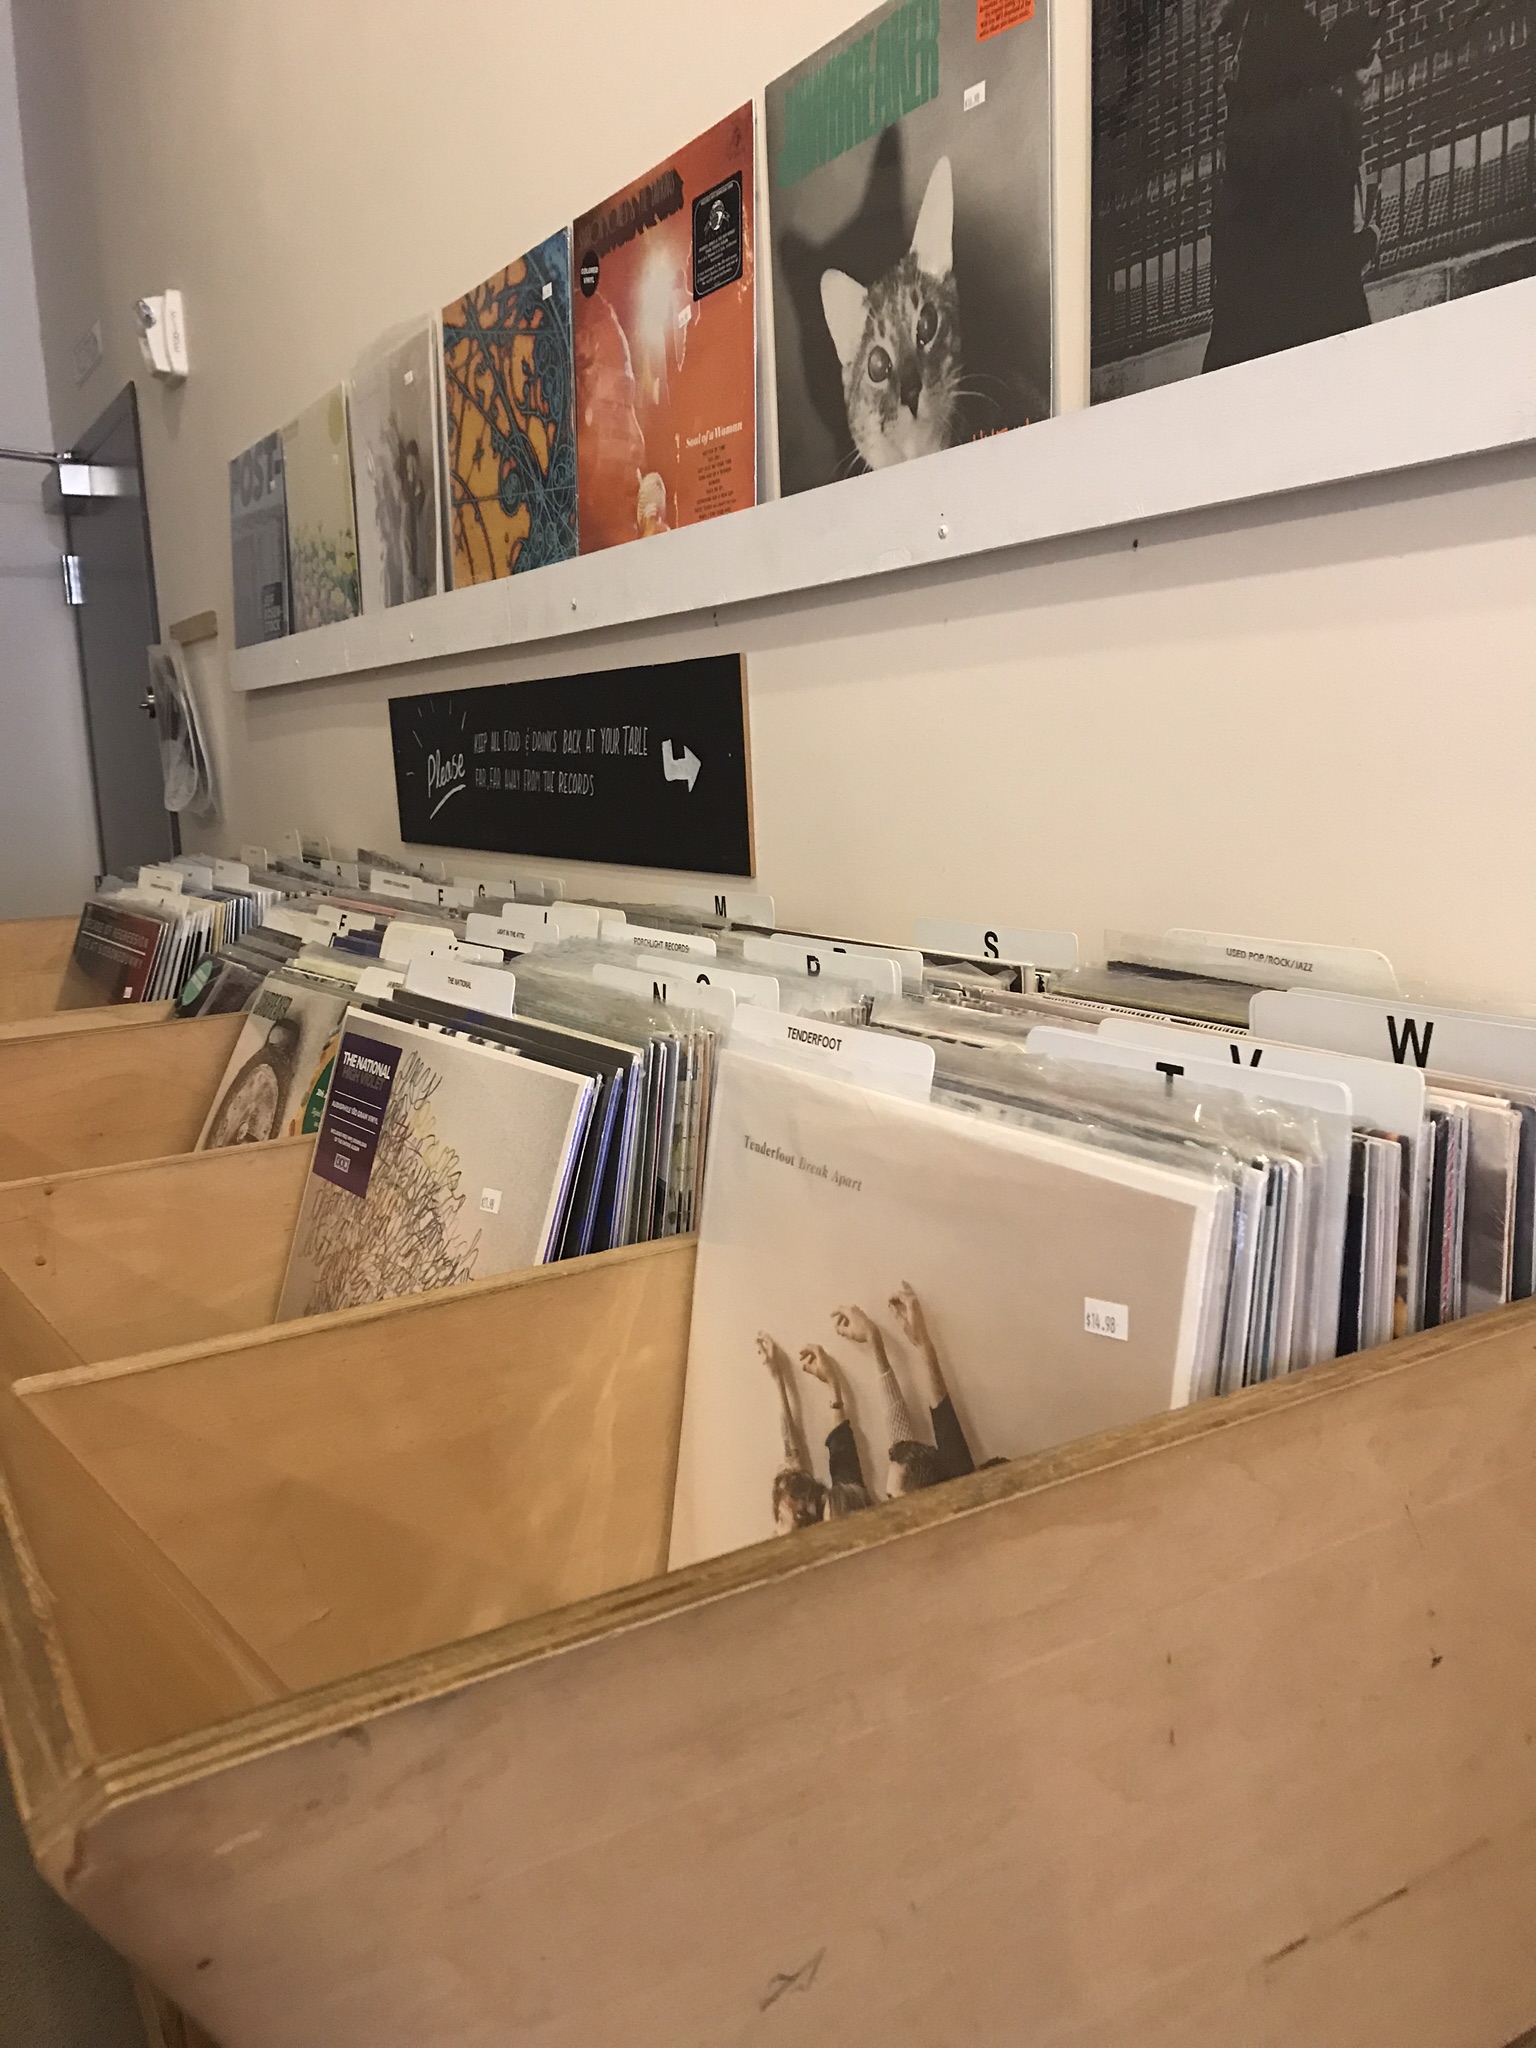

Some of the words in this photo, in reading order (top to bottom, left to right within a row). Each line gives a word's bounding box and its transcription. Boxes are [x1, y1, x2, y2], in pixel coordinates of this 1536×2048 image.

[686, 433, 701, 448] Soul
[701, 430, 710, 446] of
[714, 422, 743, 438] Woman
[474, 731, 488, 754] KEEP
[491, 731, 501, 752] ALL
[504, 730, 520, 752] FOOD
[532, 730, 557, 753] DRINKS
[563, 729, 581, 754] BACK
[586, 728, 596, 753] AT
[600, 727, 620, 754] YOUR
[622, 725, 648, 756] TABLE
[428, 749, 466, 798] Please
[505, 768, 520, 790] AWAY
[524, 769, 540, 791] FROM
[543, 770, 555, 793] THE
[559, 771, 594, 796] RECORDS
[714, 895, 727, 918] M
[634, 937, 663, 949] PORCHLIGHT
[665, 941, 689, 953] RECORDS
[984, 931, 999, 958] S
[1226, 948, 1246, 958] USED
[455, 979, 471, 989] NATIONAL
[653, 981, 666, 1006] N
[787, 1026, 842, 1051] TENDERFOOT
[1386, 1015, 1434, 1068] W
[343, 1051, 358, 1067] THE
[356, 1057, 391, 1080] NATIONAL
[360, 1074, 385, 1091] VIOLET
[1156, 1061, 1184, 1098] T
[744, 1135, 795, 1166] Tenderfoot
[798, 1157, 828, 1178] Break
[831, 1169, 862, 1191] Apart
[1086, 1312, 1116, 1334] $14.98
